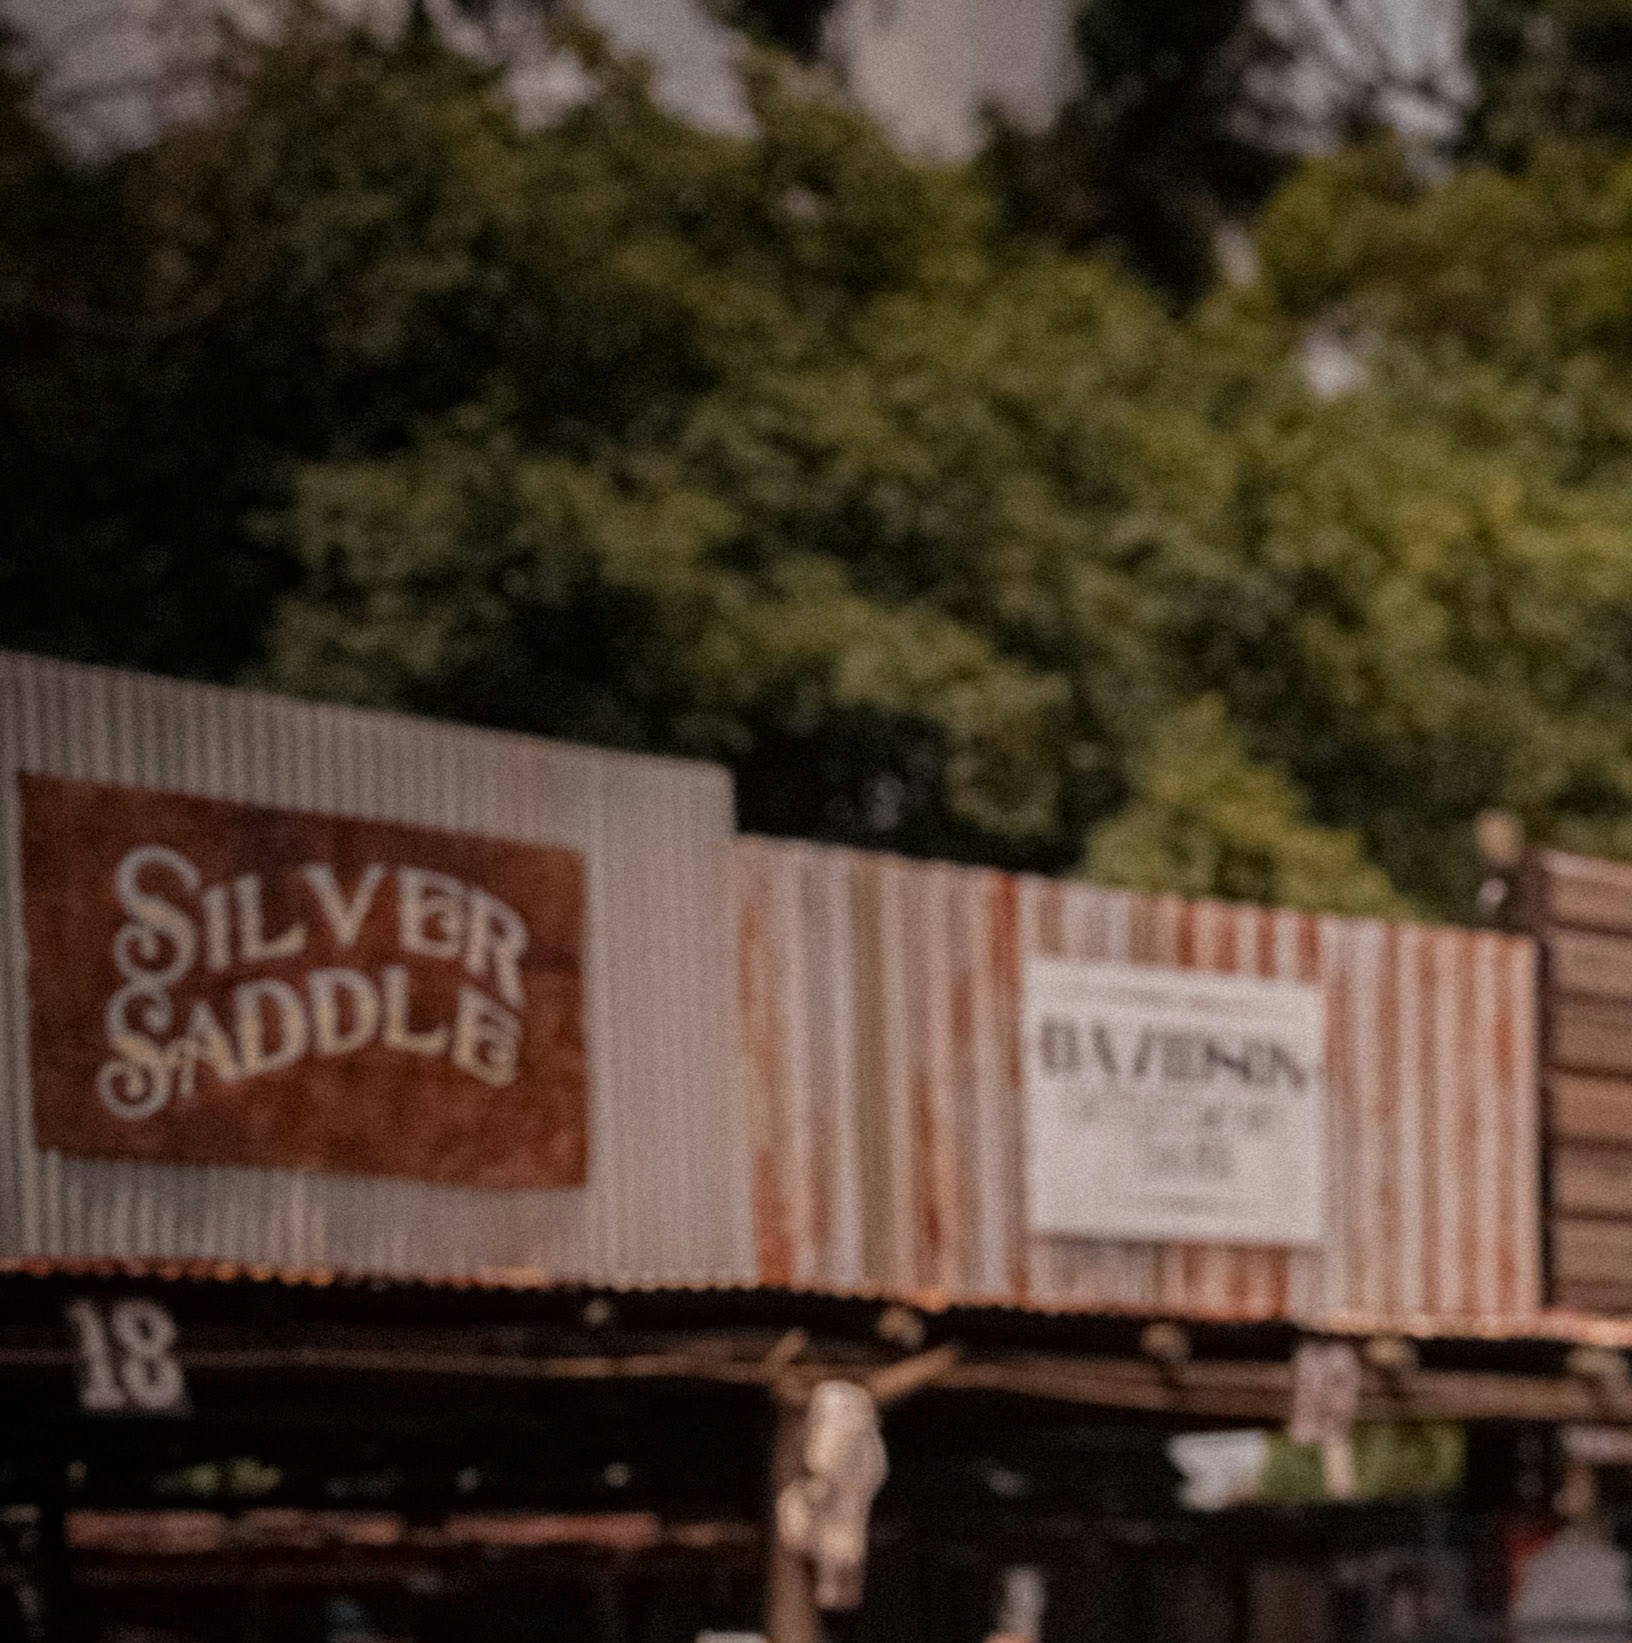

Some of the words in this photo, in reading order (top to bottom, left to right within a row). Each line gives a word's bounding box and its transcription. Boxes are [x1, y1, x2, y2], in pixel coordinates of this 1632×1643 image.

[114, 845, 529, 1010] SILVER
[97, 965, 523, 1121] SADDLE
[70, 1299, 186, 1412] 18
